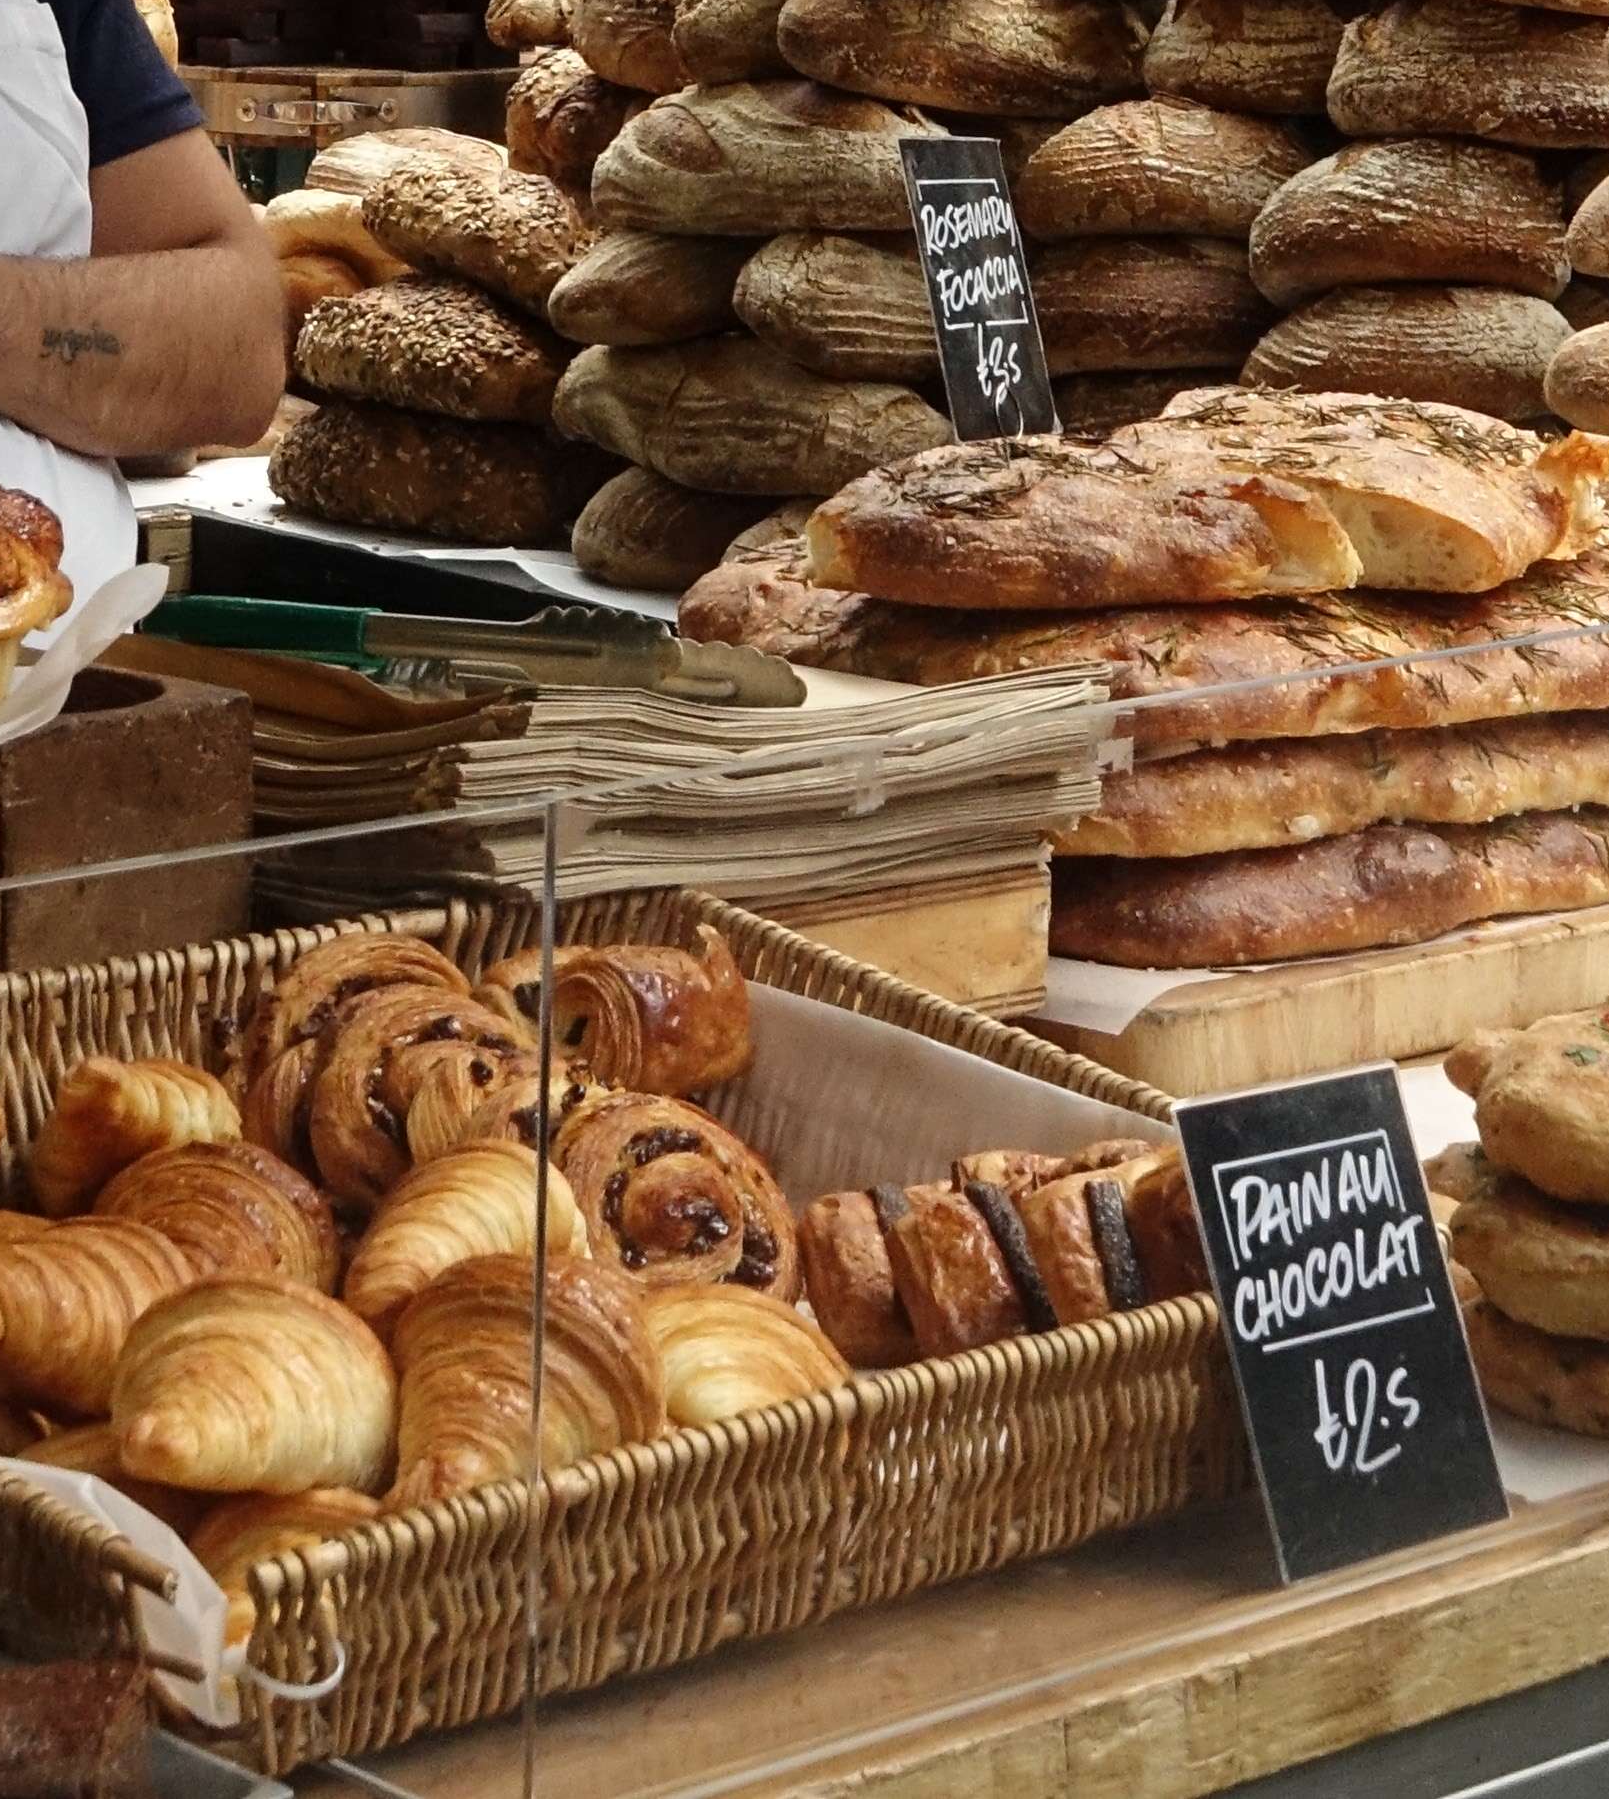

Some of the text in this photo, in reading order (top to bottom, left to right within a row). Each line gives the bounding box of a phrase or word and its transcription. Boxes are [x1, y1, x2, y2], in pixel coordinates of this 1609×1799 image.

[920, 195, 1016, 256] ROSEMARY
[936, 254, 1024, 317] FOCACCIA
[1231, 1147, 1395, 1260] PAIN AU
[1234, 1214, 1423, 1341] CHOCOLAT
[1314, 1358, 1420, 1473] £2.5
